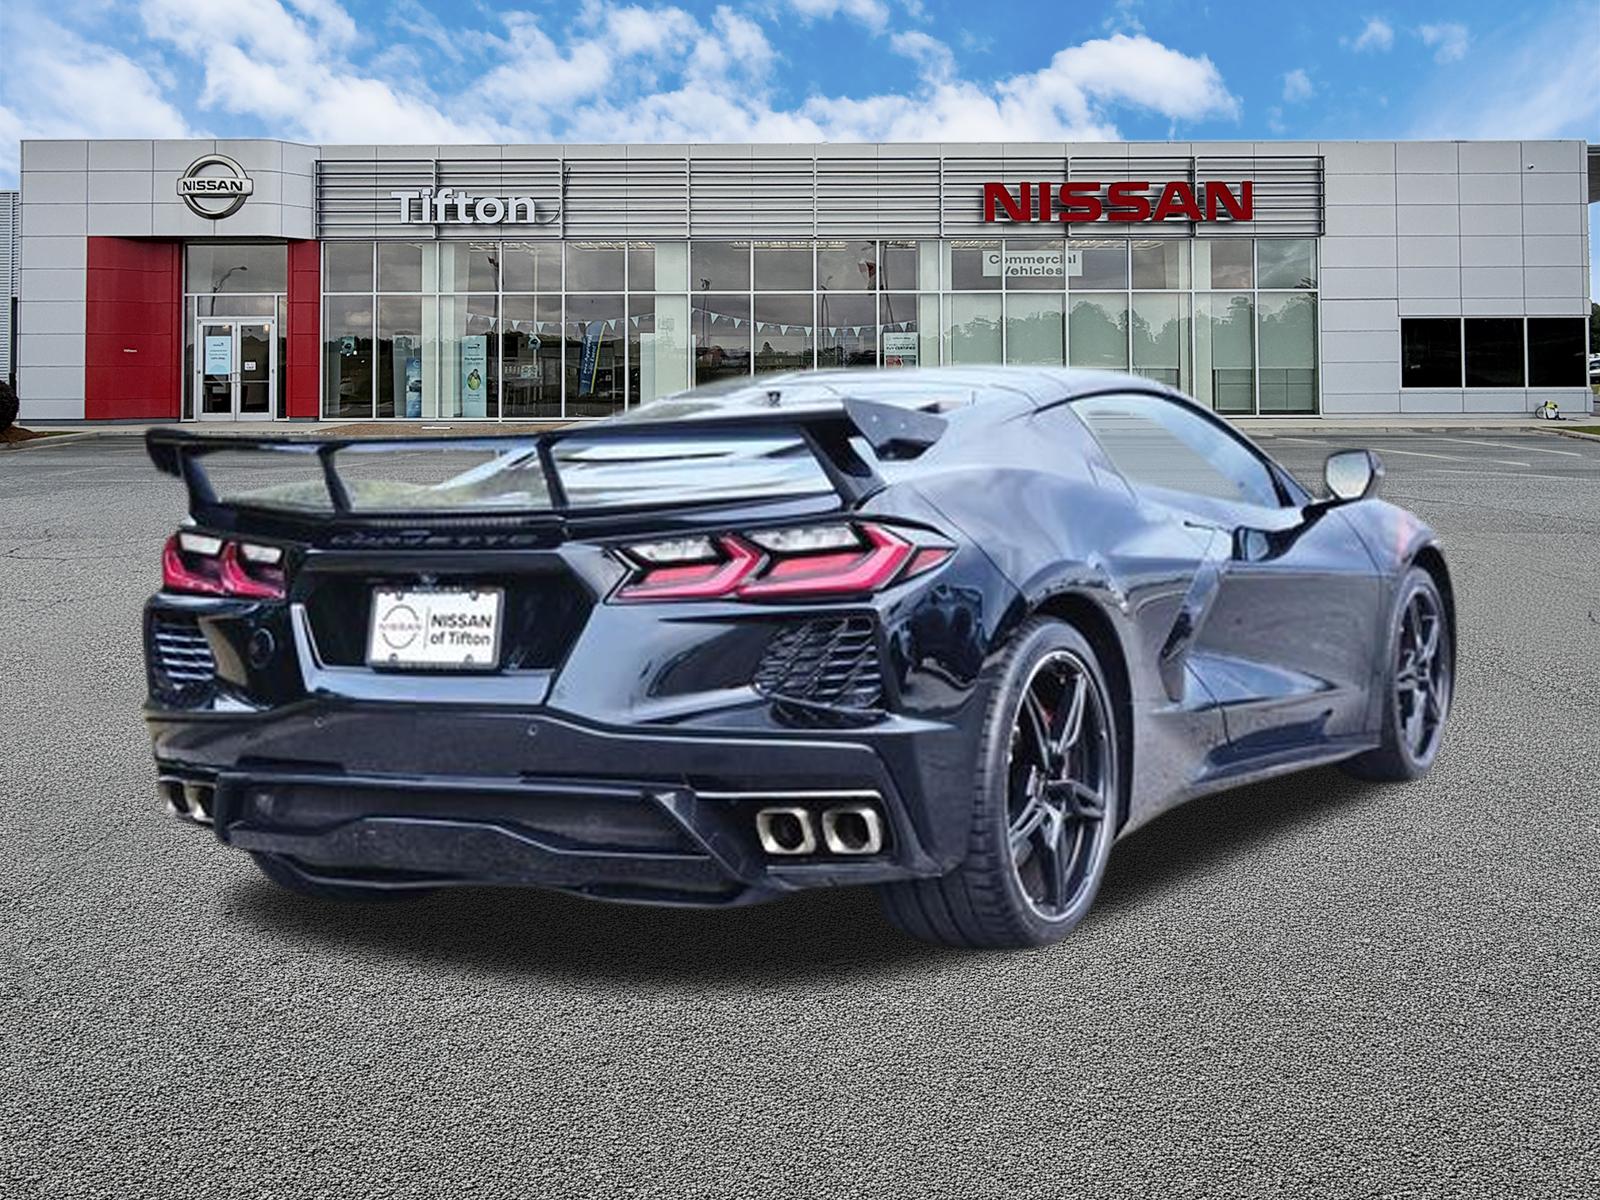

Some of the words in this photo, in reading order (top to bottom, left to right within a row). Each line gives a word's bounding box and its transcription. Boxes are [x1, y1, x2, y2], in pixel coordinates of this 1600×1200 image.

[182, 179, 244, 193] NISSAN
[391, 188, 536, 225] Tifton
[983, 181, 1253, 222] NISSAN
[378, 622, 423, 631] NISSAN
[430, 613, 493, 629] NISSAN
[430, 631, 446, 645] of
[449, 631, 491, 646] Tifton
